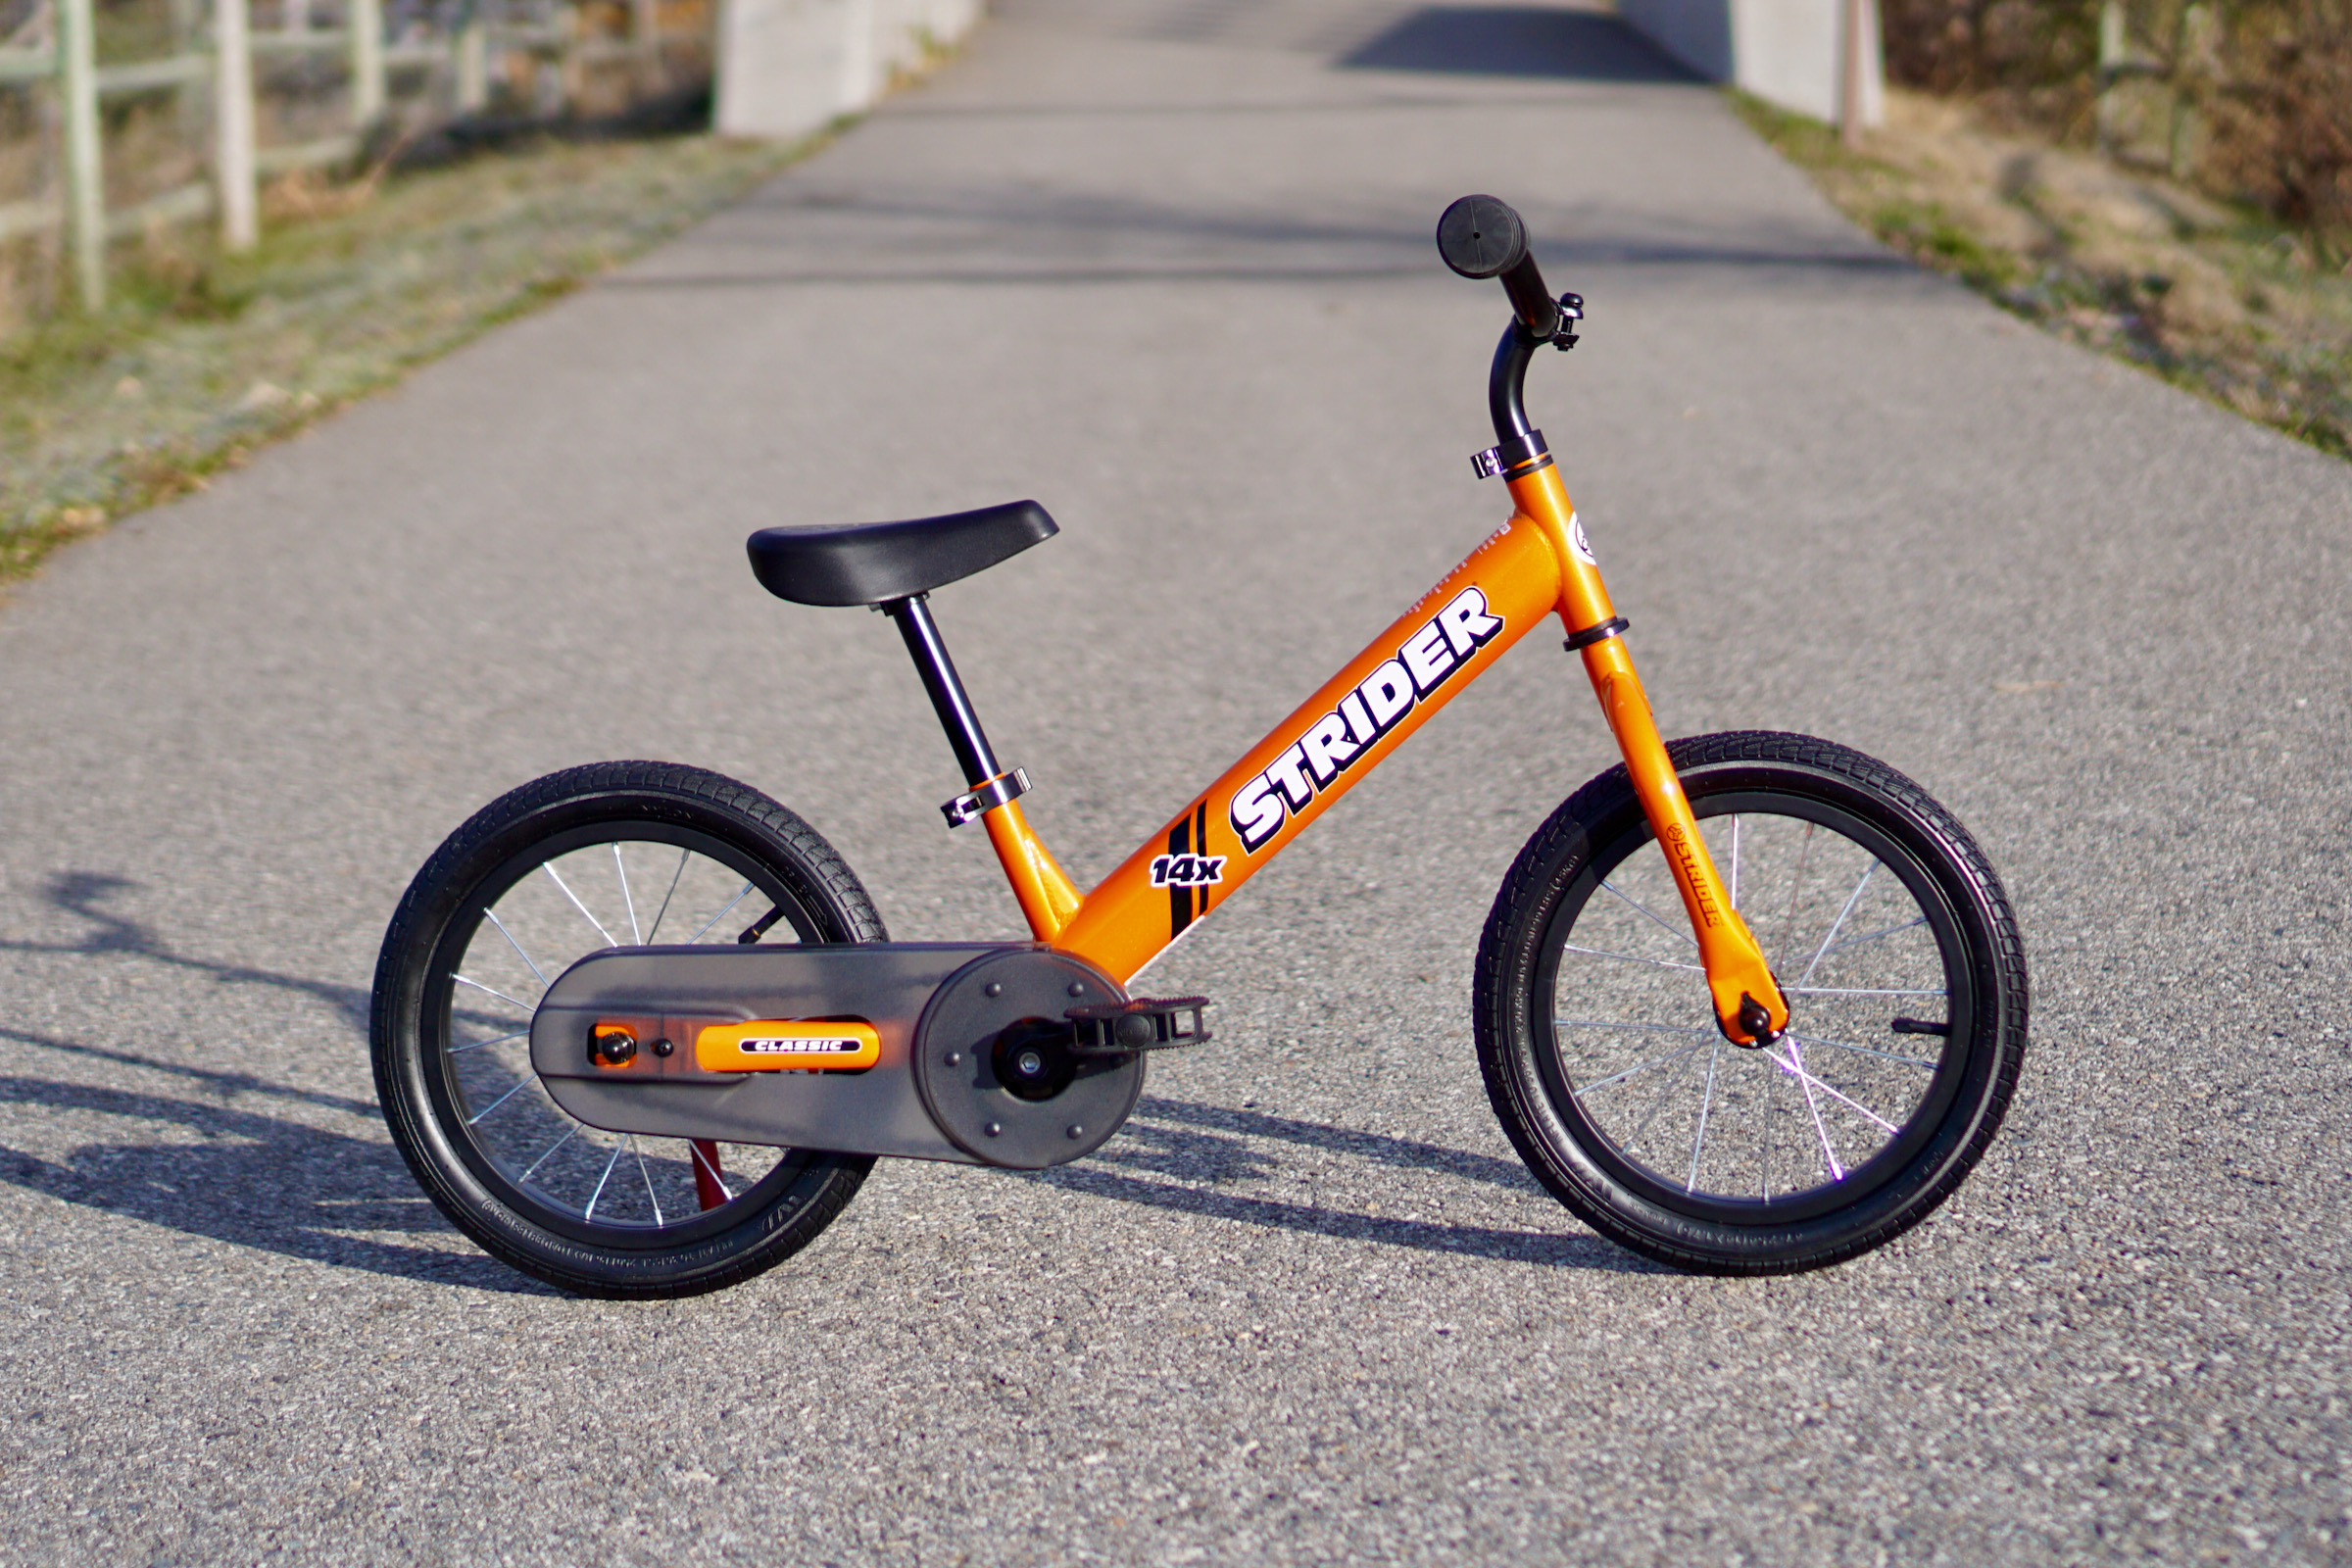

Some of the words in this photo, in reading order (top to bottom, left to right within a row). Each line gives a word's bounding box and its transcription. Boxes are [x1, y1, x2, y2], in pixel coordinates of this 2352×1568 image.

[1231, 586, 1503, 855] STRIDER
[1674, 842, 1724, 928] STRIDER
[755, 1041, 843, 1052] CLASSIC
